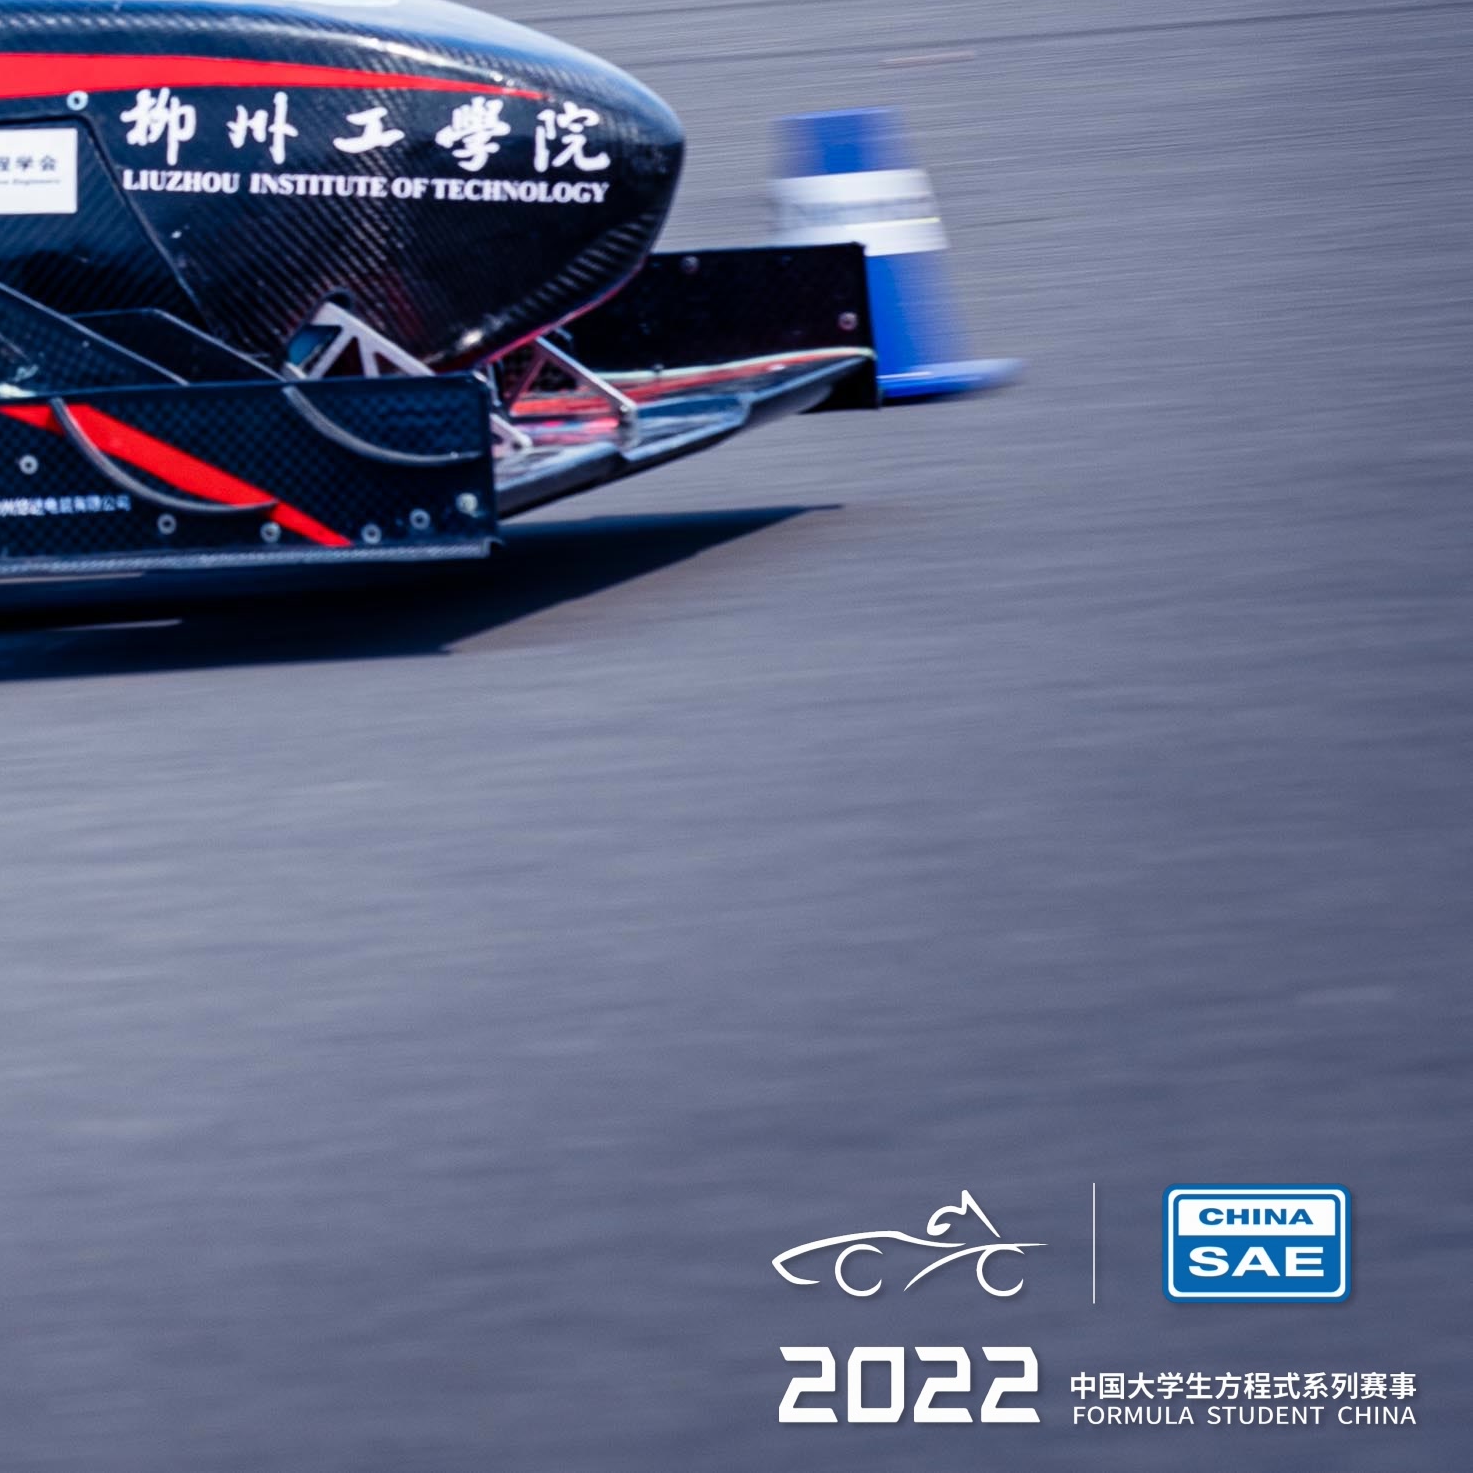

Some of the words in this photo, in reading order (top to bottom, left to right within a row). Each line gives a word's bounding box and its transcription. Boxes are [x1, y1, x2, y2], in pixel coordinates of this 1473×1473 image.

[121, 168, 242, 195] LIUZHOU
[249, 172, 388, 199] INSTITUTE
[391, 177, 430, 200] OF
[430, 177, 611, 204] TECHNOLOGY
